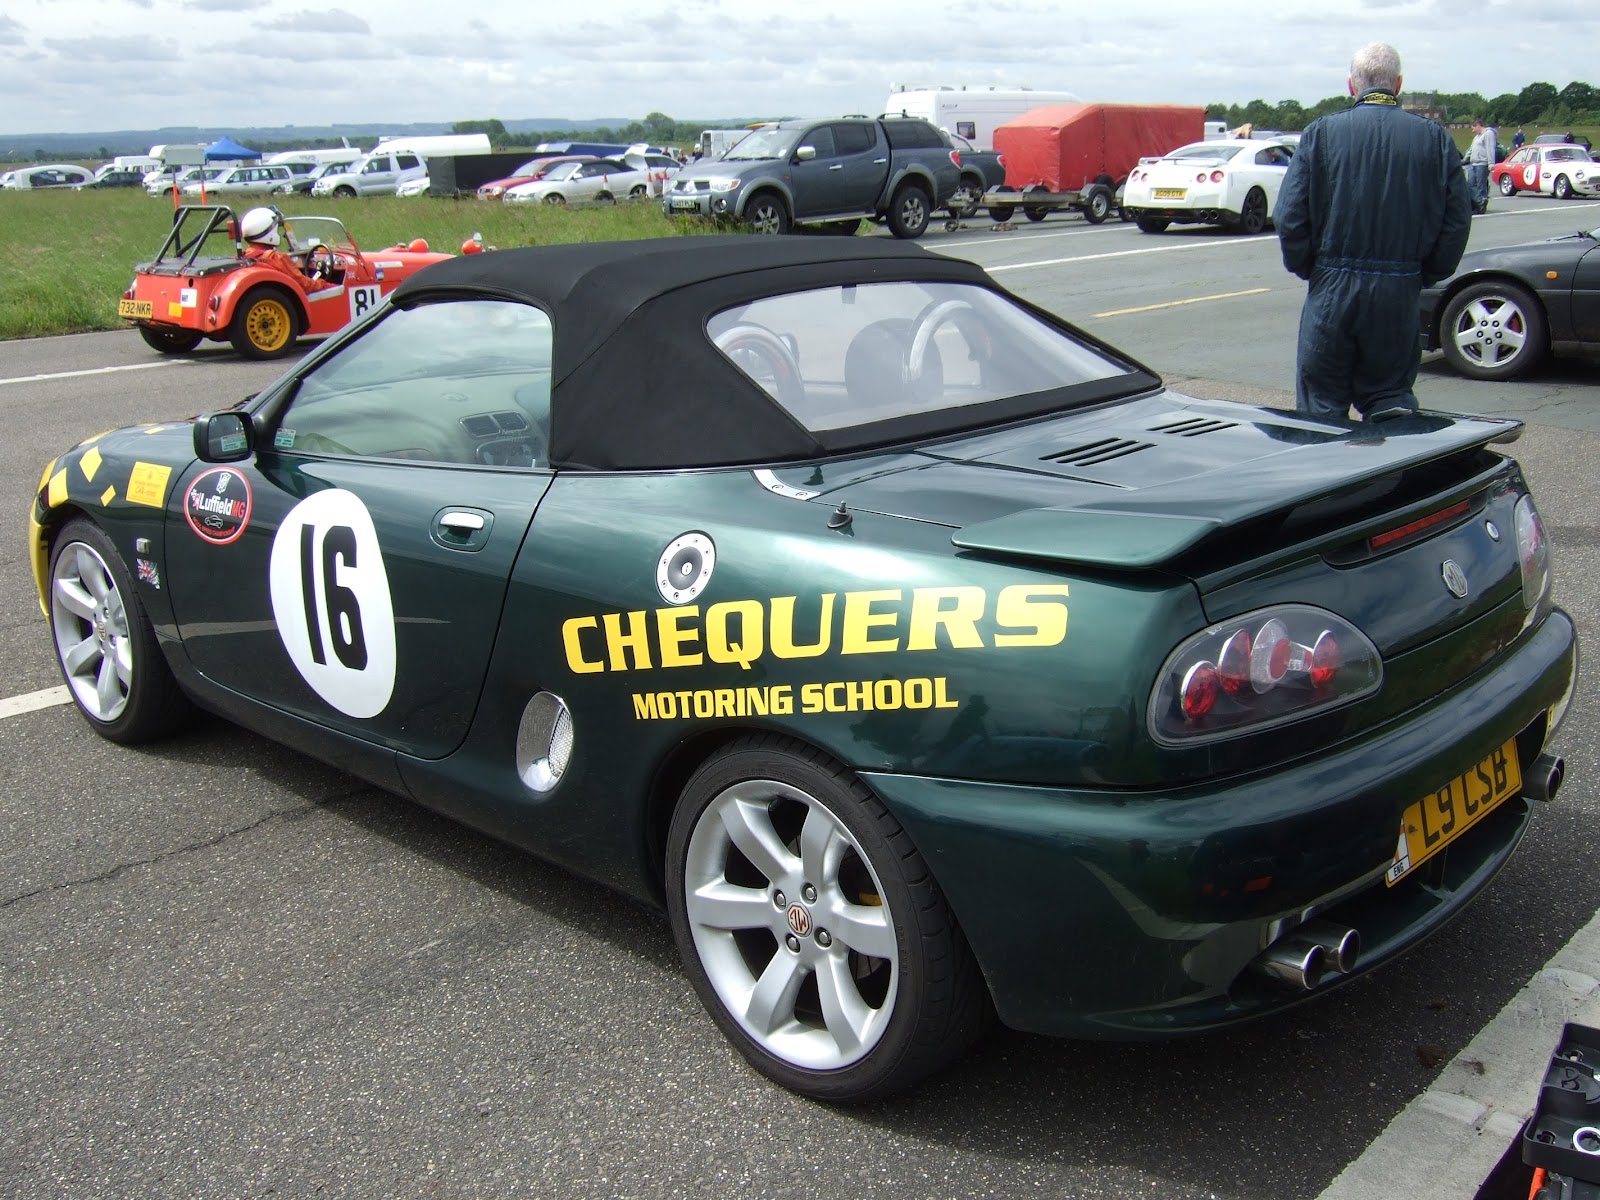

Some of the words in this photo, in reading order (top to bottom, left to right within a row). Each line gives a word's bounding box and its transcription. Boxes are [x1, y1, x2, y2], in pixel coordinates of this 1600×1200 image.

[1526, 169, 1533, 181] 41
[121, 301, 136, 314] 732
[136, 302, 152, 316] NKR
[355, 289, 376, 317] 81
[301, 523, 368, 671] 16
[562, 584, 1069, 674] CHEQUERS
[632, 685, 794, 720] MOTORING
[801, 677, 959, 714] SCHOOL
[1420, 786, 1456, 849] L9
[1461, 746, 1508, 817] CSB
[1393, 862, 1405, 877] ENG
